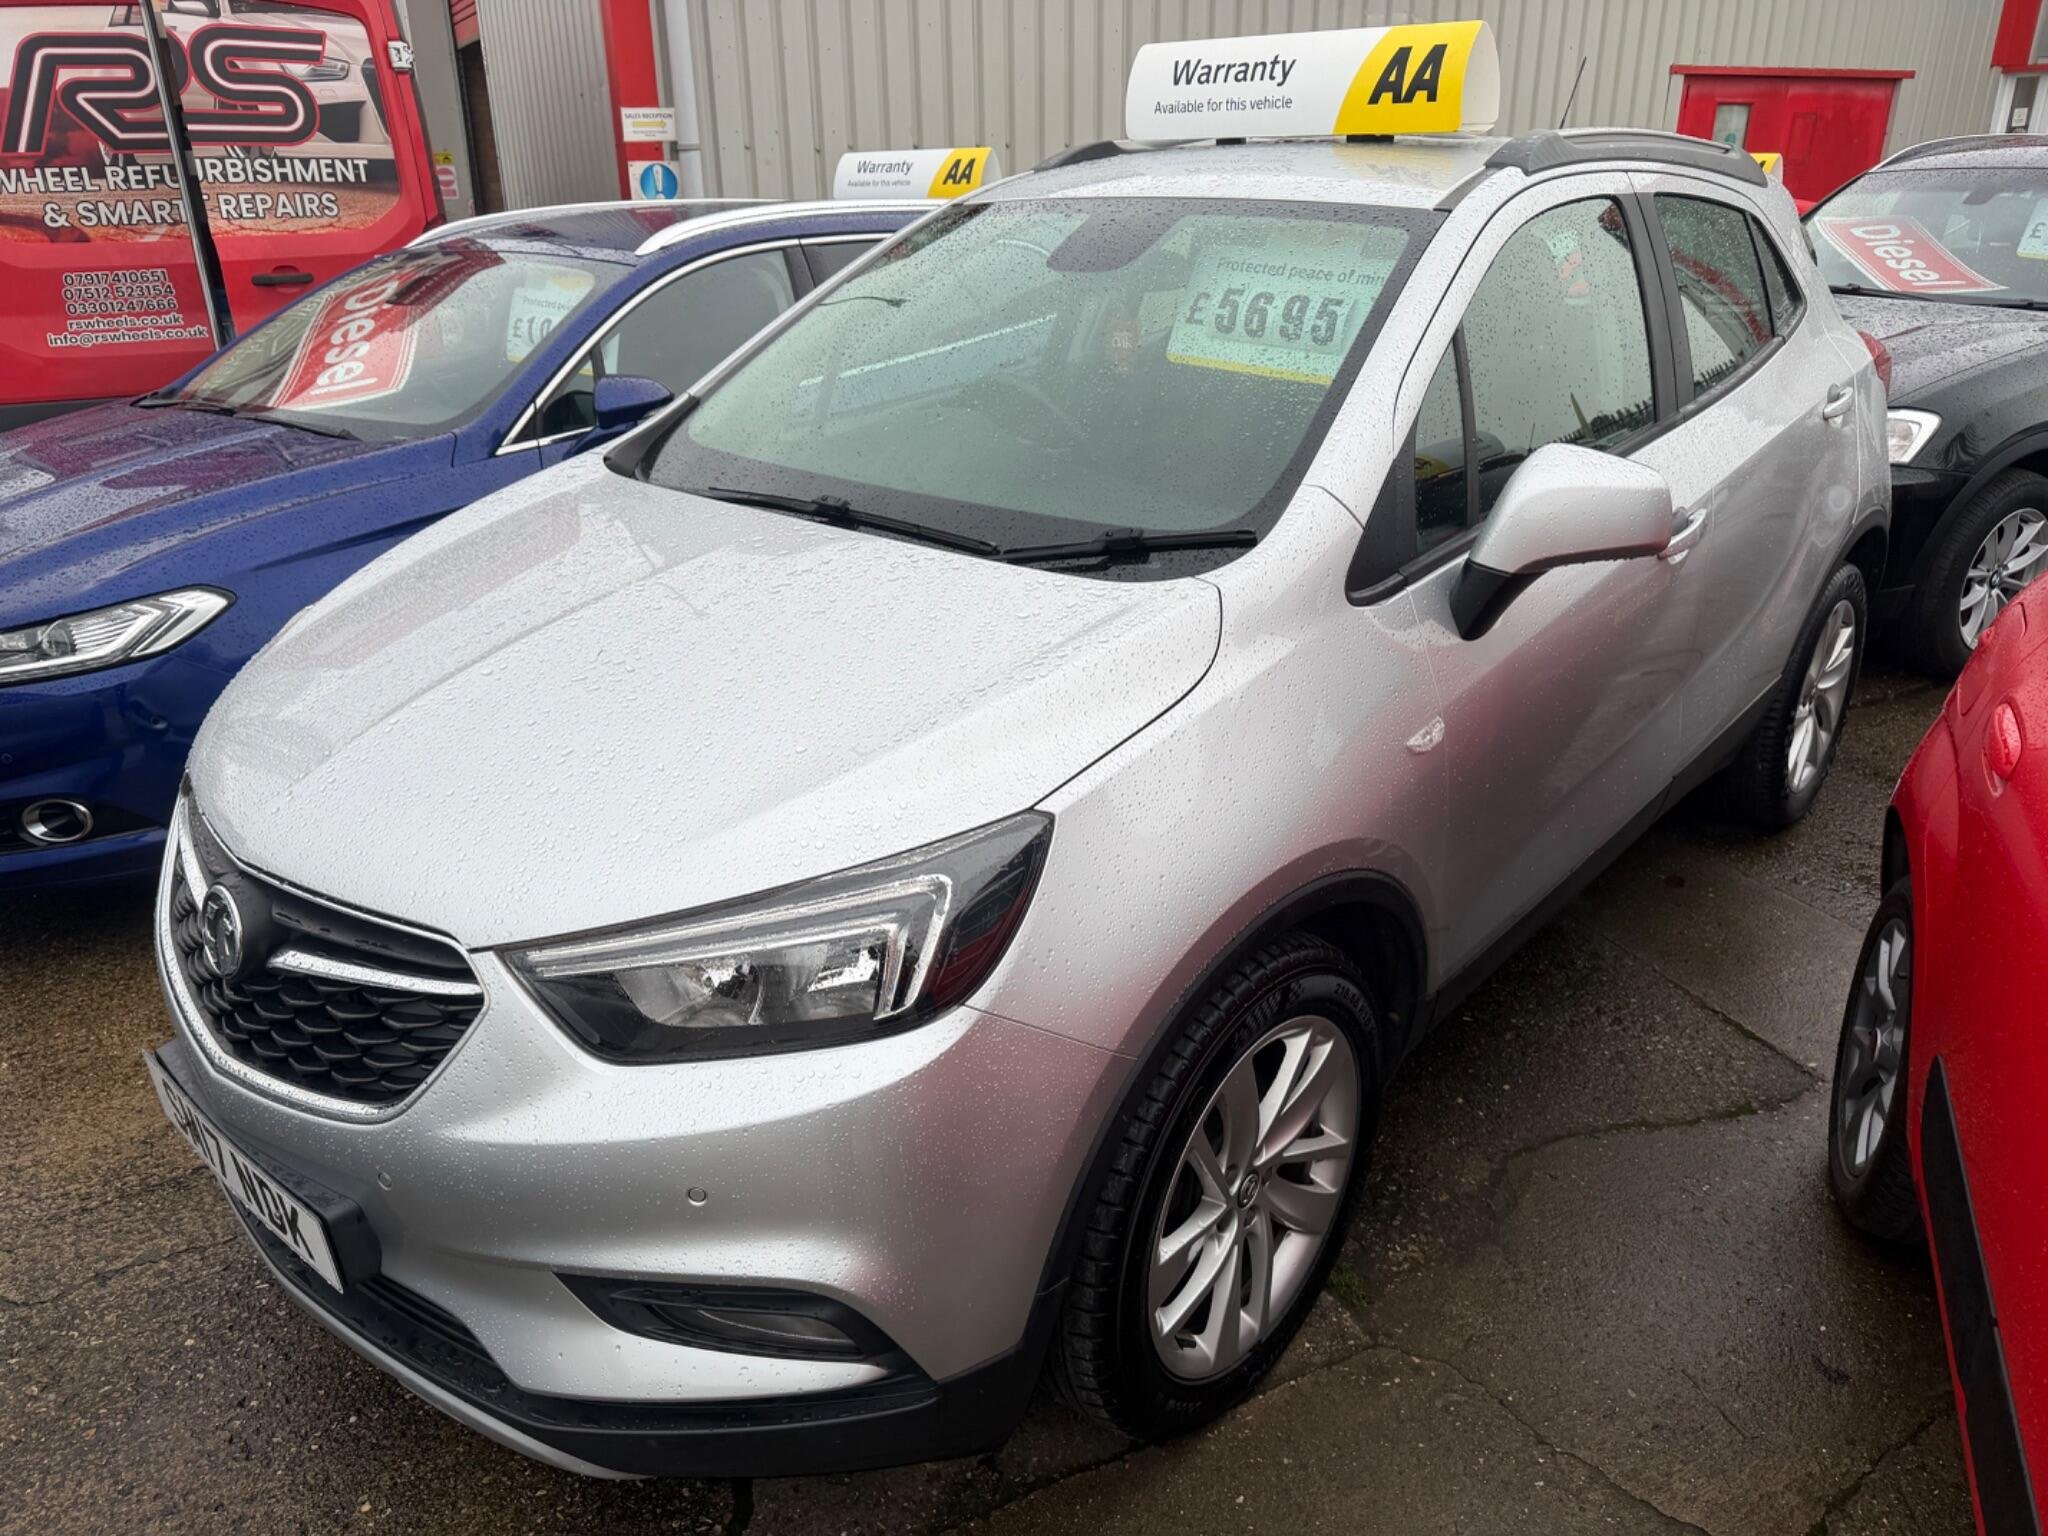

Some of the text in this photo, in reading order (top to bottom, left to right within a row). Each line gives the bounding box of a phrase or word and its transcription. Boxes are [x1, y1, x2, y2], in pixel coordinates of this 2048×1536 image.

[1172, 54, 1297, 86] Warranty
[1367, 44, 1448, 106] AA
[2, 24, 327, 154] RS
[1154, 95, 1293, 115] Available for this vehicle
[857, 160, 913, 176] Warranty
[942, 158, 976, 185] AA
[847, 179, 871, 188] Available
[43, 201, 72, 228] &
[217, 192, 340, 221] REPAIRS
[1850, 225, 1966, 286] Diesel
[1216, 257, 1385, 287] Protected peace of min
[62, 284, 176, 301] 07512 523154
[66, 298, 178, 315] 03301247666
[68, 312, 184, 331] rswheels.co.uk
[1185, 288, 1344, 346] £5695
[47, 325, 209, 348] info@rswheels.co.uk
[309, 281, 399, 395] Diesel
